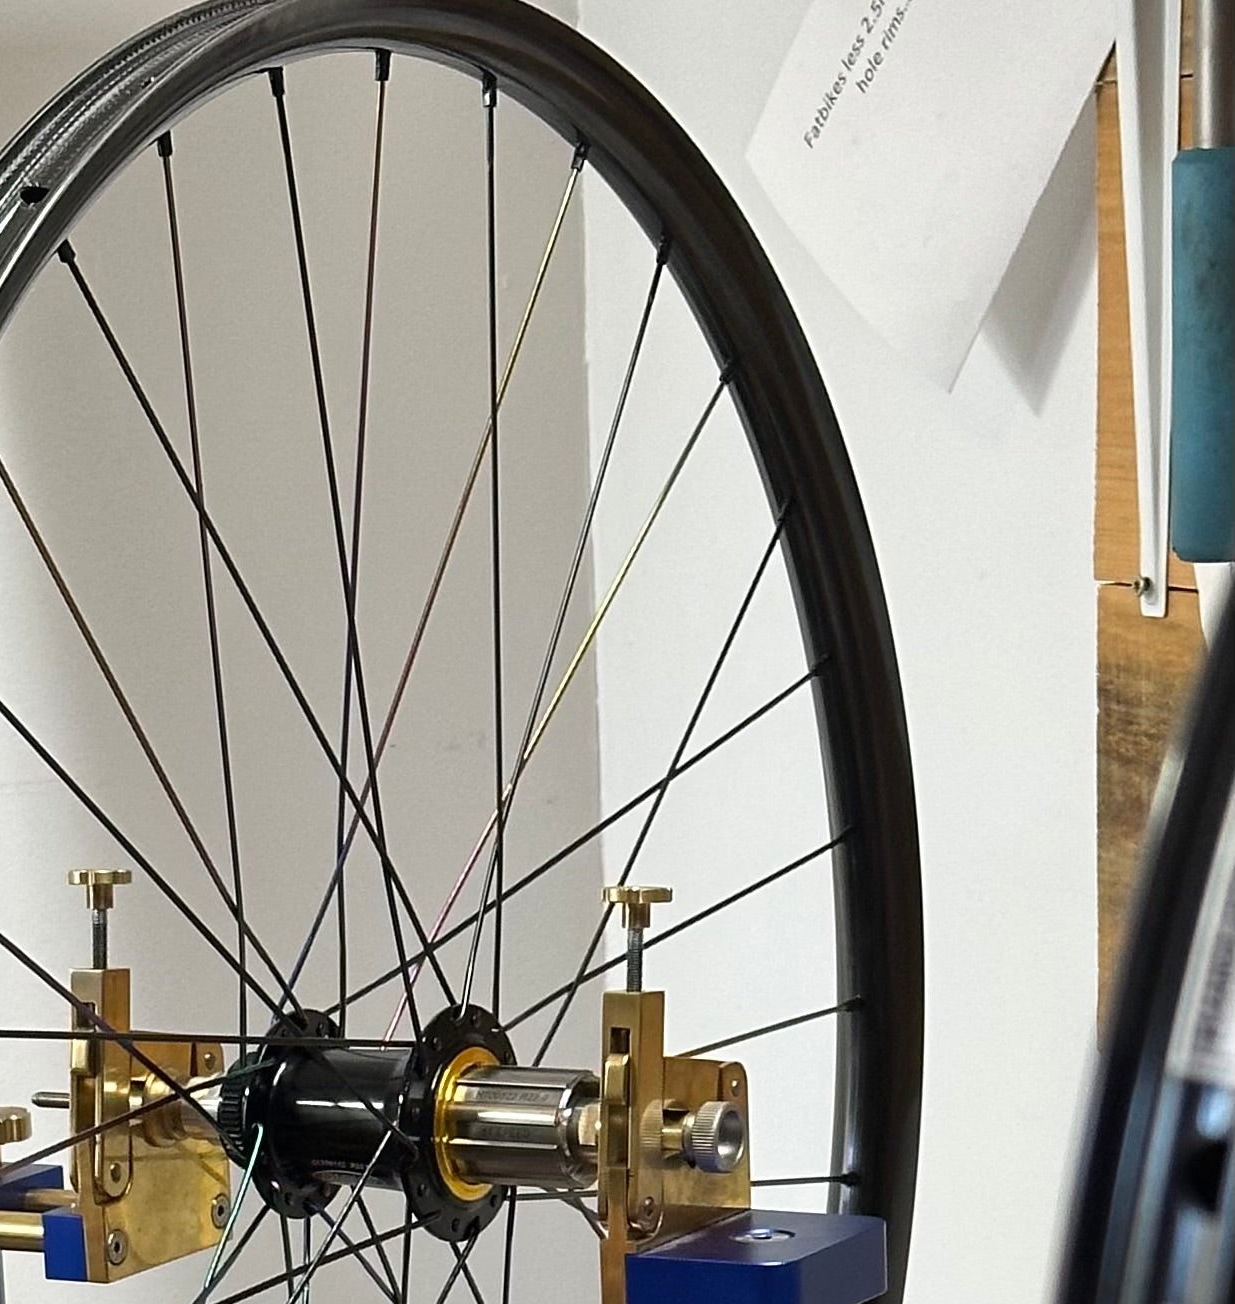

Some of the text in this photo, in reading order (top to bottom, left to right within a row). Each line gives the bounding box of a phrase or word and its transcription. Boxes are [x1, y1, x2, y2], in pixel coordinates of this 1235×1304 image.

[803, 71, 847, 149] Fatbikes
[841, 34, 865, 72] less
[855, 51, 885, 94] hole
